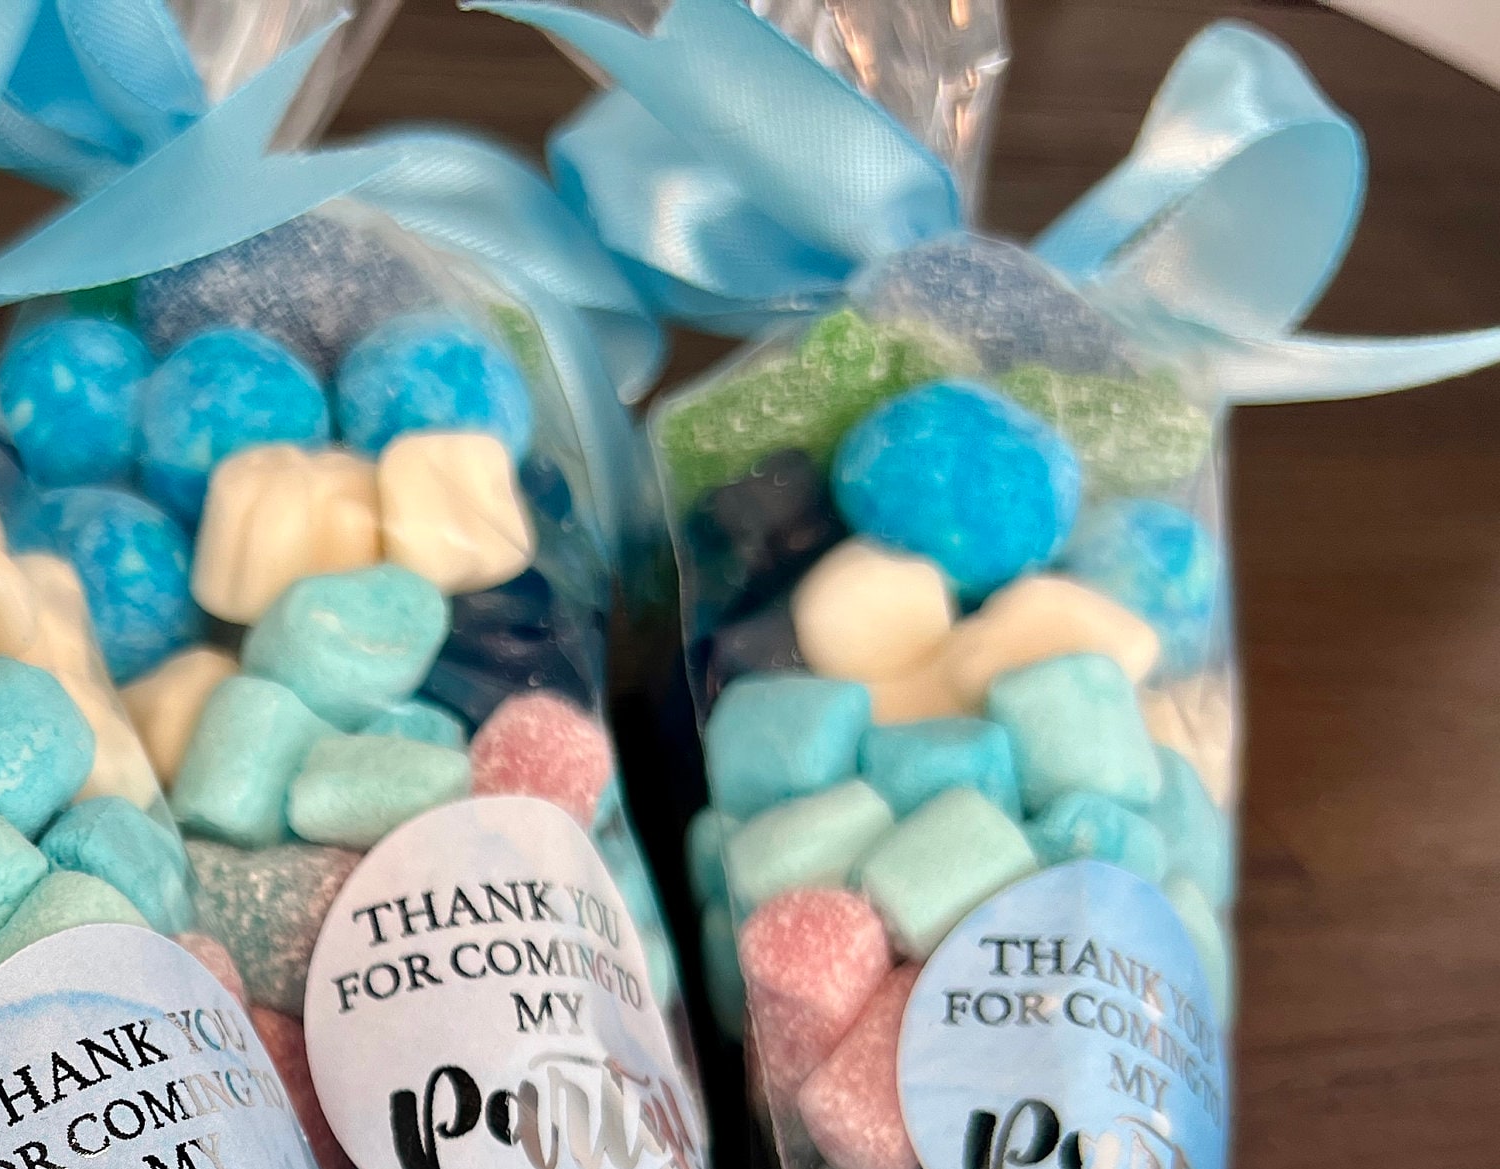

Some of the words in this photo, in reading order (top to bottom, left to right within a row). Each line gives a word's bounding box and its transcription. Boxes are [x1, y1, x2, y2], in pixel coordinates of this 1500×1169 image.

[352, 880, 565, 948] THANK
[564, 884, 622, 951] YOU
[331, 954, 442, 1014] FOR
[449, 938, 613, 993] COMING
[979, 935, 1164, 1013] THANK
[164, 1008, 247, 1054] YOU
[509, 992, 584, 1036] MY
[941, 990, 1054, 1028] FOR
[1063, 991, 1202, 1097] COMING
[67, 1067, 256, 1159] COMING
[1108, 1051, 1170, 1113] MY
